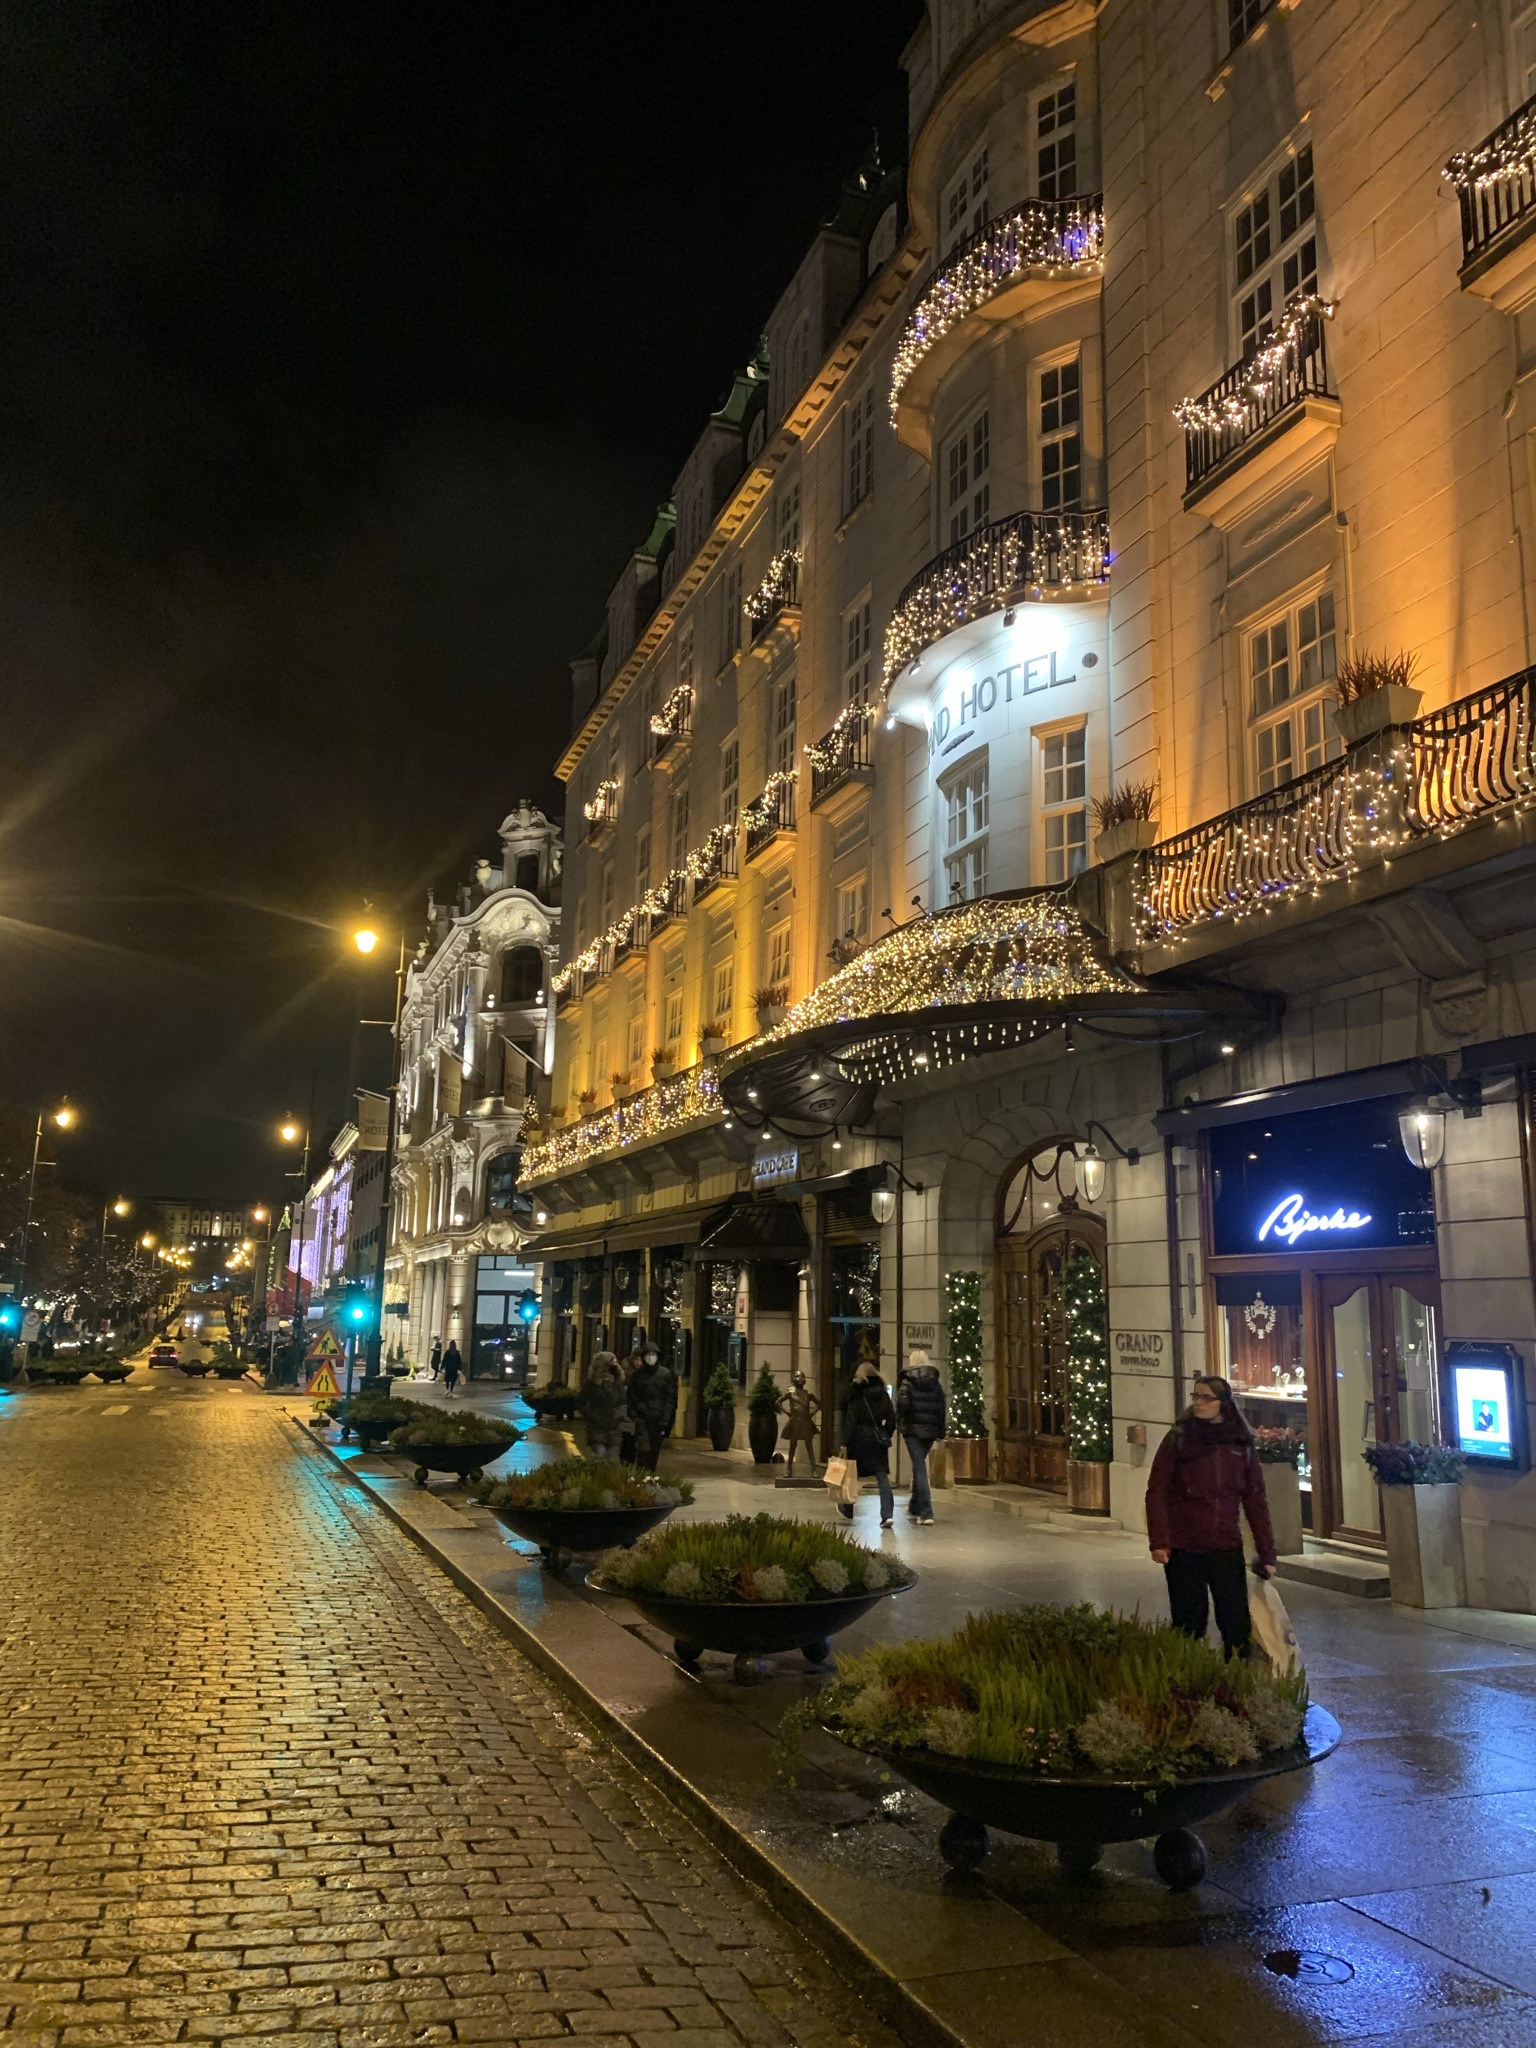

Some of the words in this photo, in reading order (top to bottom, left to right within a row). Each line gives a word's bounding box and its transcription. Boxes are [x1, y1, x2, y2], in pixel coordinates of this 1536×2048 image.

[960, 651, 1076, 726] HOTEL
[1258, 1193, 1372, 1245] Bjerke
[906, 1325, 935, 1340] GRAND
[1115, 1333, 1163, 1353] GRAND
